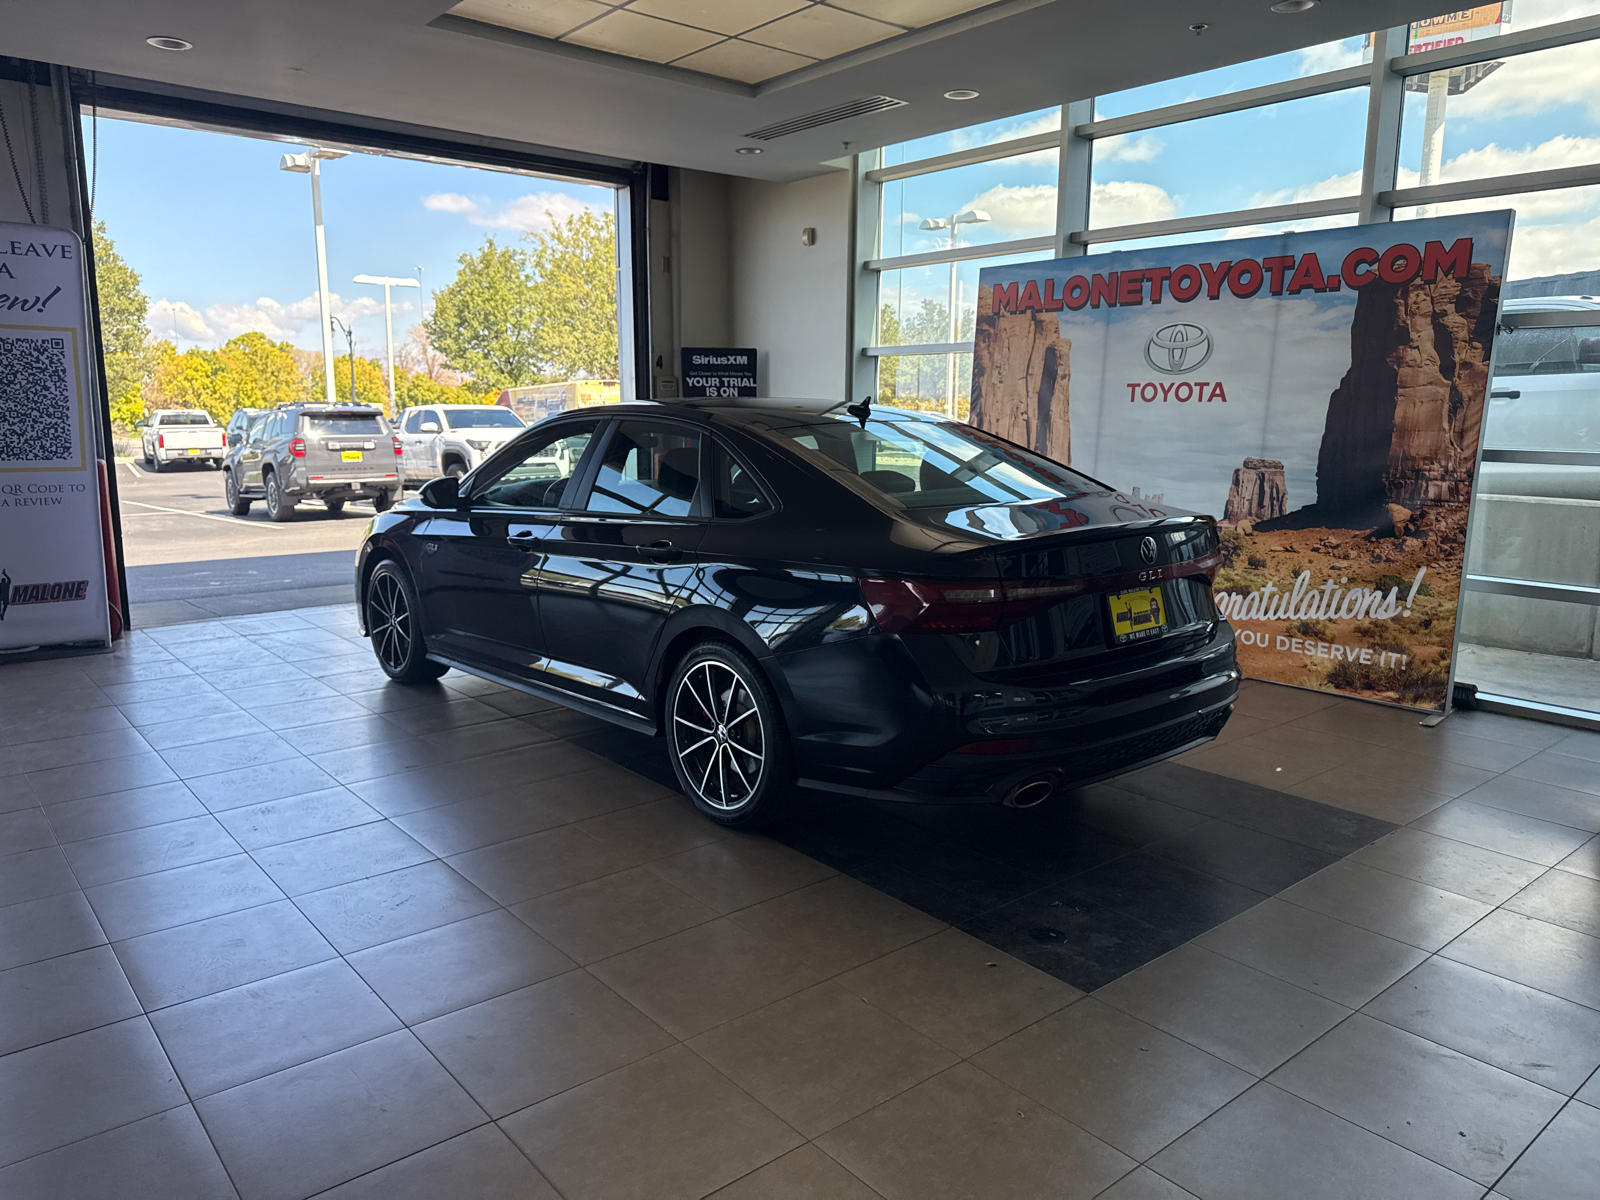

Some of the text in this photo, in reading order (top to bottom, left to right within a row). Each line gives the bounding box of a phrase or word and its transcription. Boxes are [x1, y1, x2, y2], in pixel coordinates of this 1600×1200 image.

[991, 237, 1474, 315] MALONETOYOTA.COM
[656, 354, 664, 369] 4
[692, 355, 748, 365] SiriusXM
[685, 377, 720, 387] YOUR
[721, 377, 757, 388] TRIAL
[706, 387, 739, 397] IS ON
[1126, 381, 1228, 403] TOYOTA
[1, 484, 24, 496] QR
[1, 497, 63, 508] A REVIEW
[1138, 569, 1163, 581] GLI
[10, 579, 89, 606] MALONE
[1276, 635, 1374, 665] DESERVE
[1379, 650, 1408, 671] IT!
